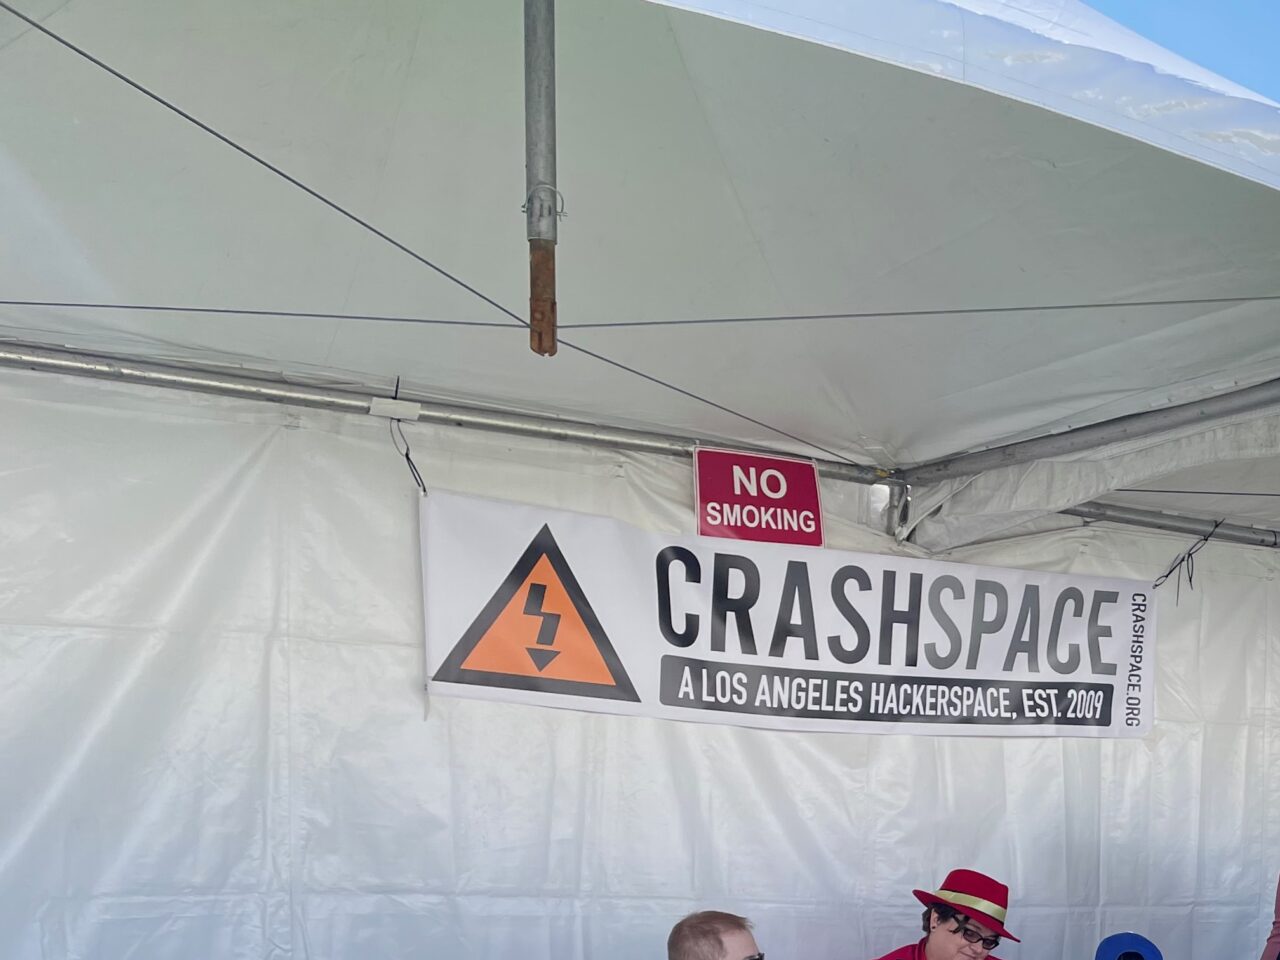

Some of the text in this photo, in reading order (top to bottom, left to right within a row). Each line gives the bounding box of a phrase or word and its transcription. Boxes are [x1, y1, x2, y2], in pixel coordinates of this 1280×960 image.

[732, 465, 787, 499] NO
[706, 502, 816, 533] SMOKING
[656, 546, 1119, 676] CRASHSPACE
[1125, 592, 1147, 727] CRASHSPACE.ORG
[678, 666, 1104, 720] A LOS ANGELES HACKERSPACE, EST. 2009
